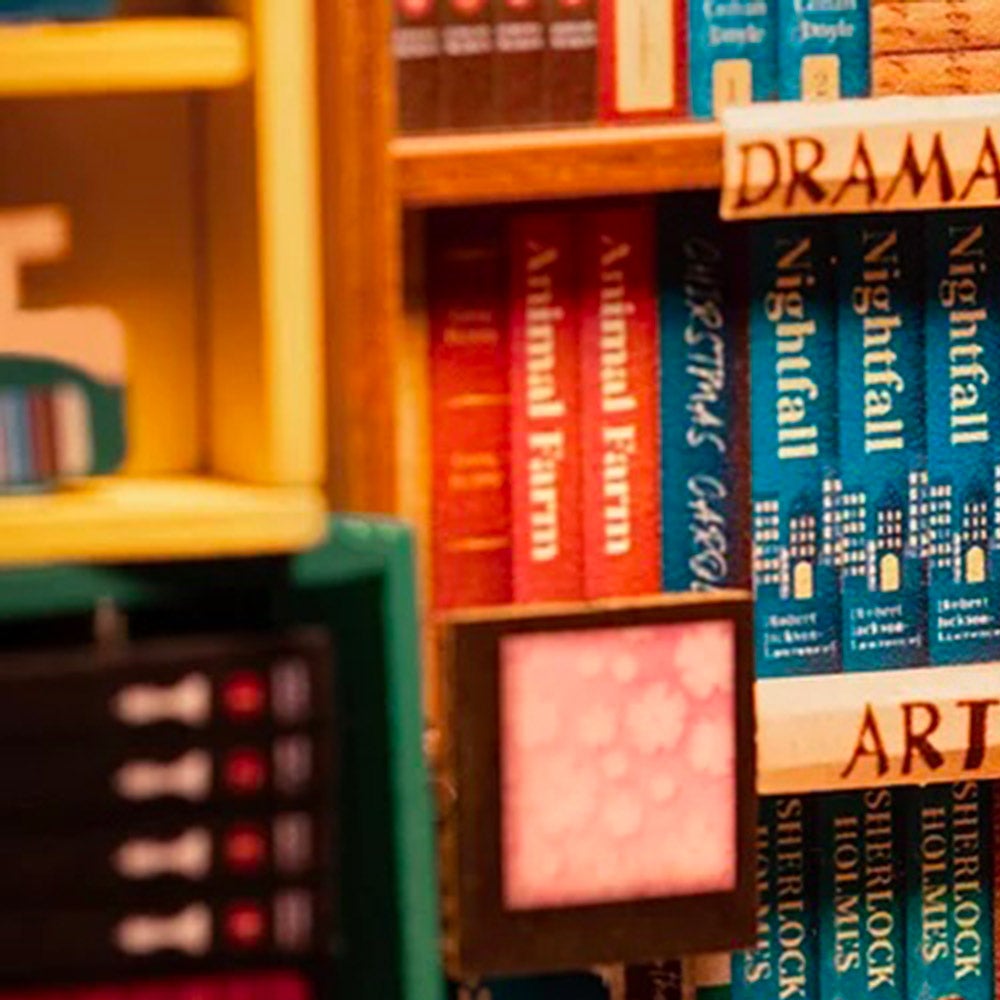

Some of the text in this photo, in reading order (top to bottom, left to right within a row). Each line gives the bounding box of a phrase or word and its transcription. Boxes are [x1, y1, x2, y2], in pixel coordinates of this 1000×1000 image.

[526, 238, 566, 562] Animal Farm
[600, 234, 638, 556] Animal Farm
[765, 236, 819, 460] Nightfall
[852, 229, 905, 454] Nightfall
[939, 223, 990, 446] Nightfall
[841, 700, 1000, 779] ART
[777, 797, 806, 1000] SHERLOCK
[834, 815, 860, 975] HOLMES
[865, 788, 894, 990] SHERLOCK
[920, 807, 947, 964] HOLMES
[953, 779, 981, 978] SHERLOCK
